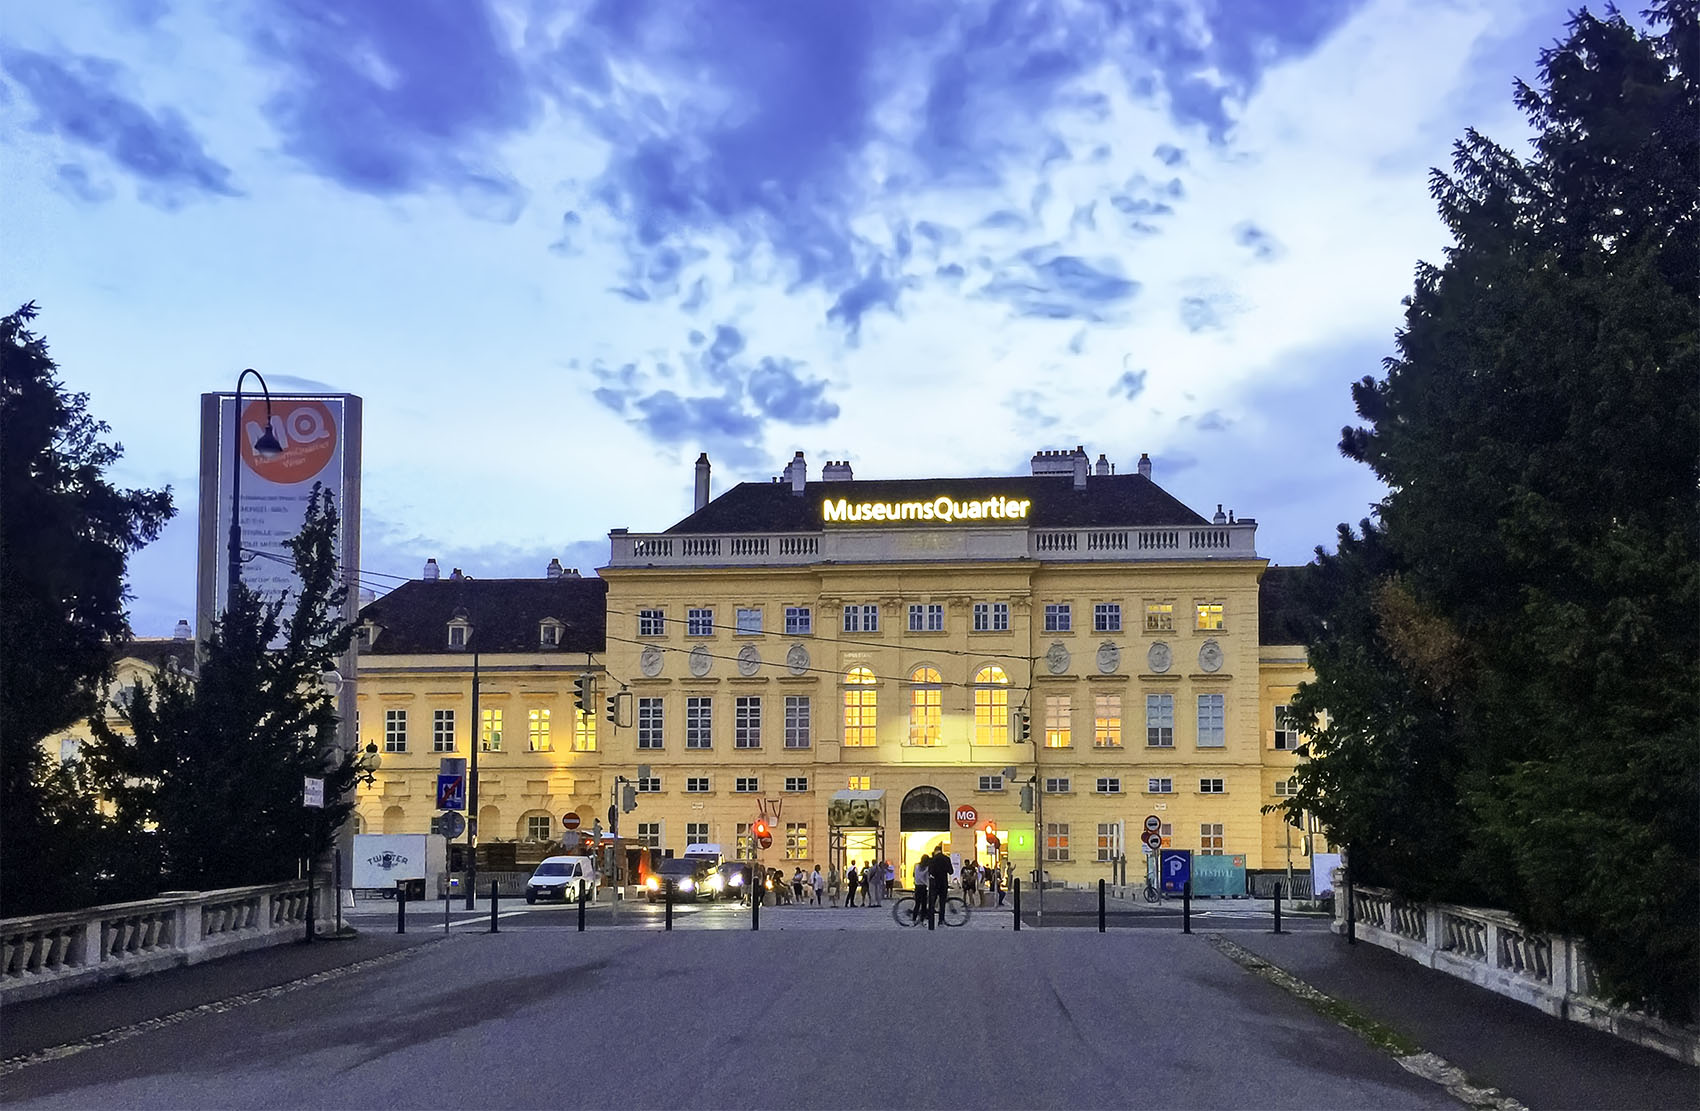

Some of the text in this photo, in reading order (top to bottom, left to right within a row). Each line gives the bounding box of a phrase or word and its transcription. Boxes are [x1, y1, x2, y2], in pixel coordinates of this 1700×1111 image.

[822, 496, 1031, 522] MuseumsQuartier
[957, 811, 976, 821] MQ
[1170, 860, 1183, 876] P
